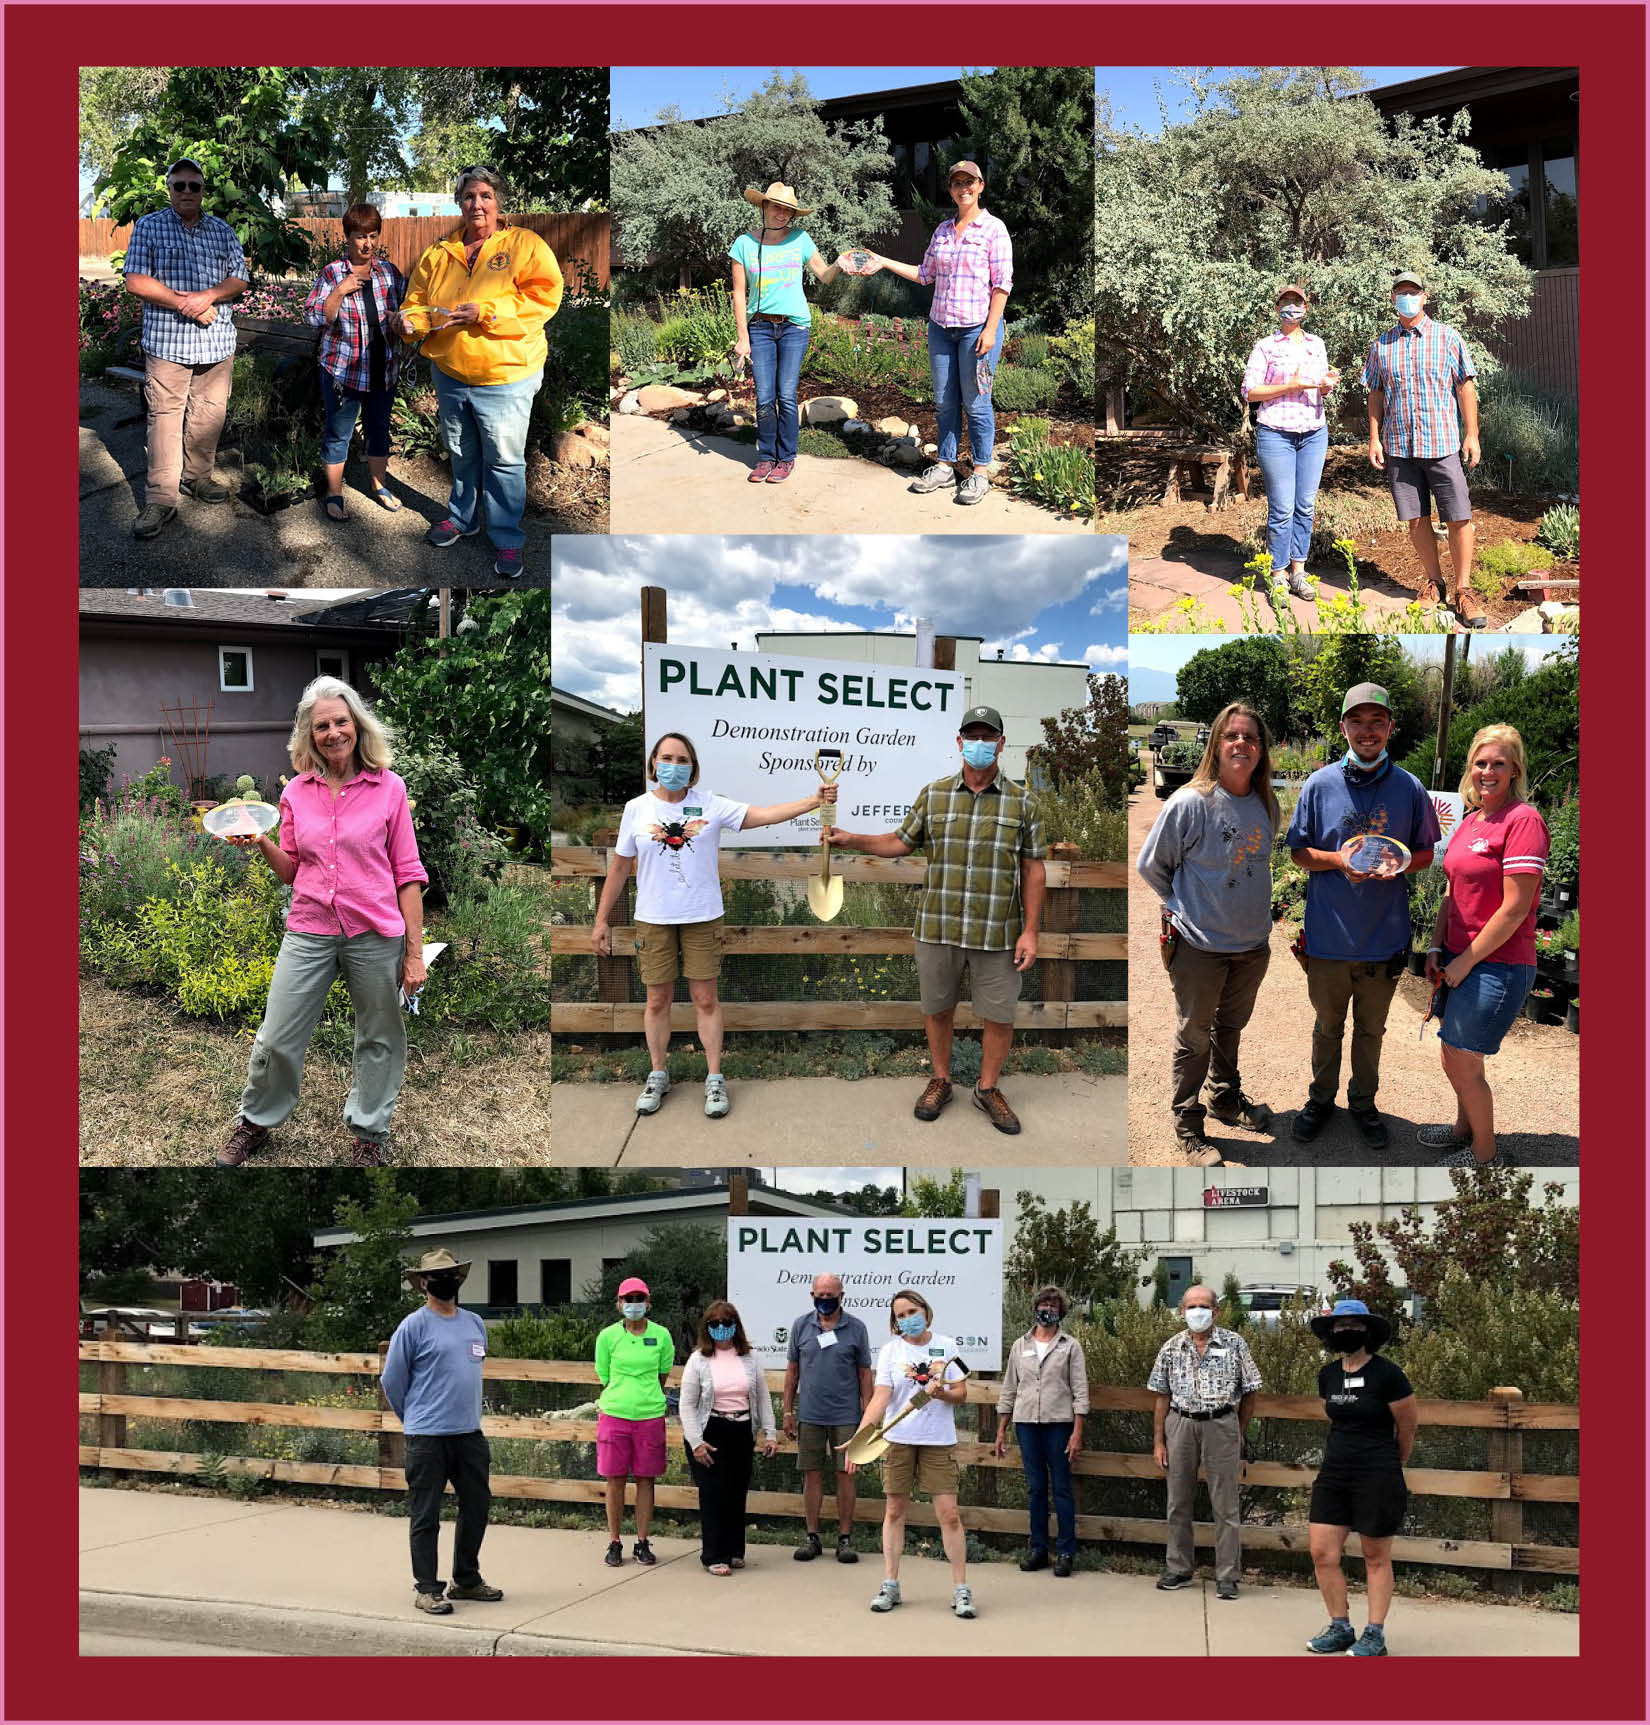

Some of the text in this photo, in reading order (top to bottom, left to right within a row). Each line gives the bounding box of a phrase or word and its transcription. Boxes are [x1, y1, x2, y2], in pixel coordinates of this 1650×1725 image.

[660, 658, 954, 712] PLANT SELECT
[711, 718, 916, 747] Demonstration Garden
[759, 751, 878, 776] Sponsored by
[790, 818, 810, 826] Plant
[1211, 1188, 1261, 1197] LIVESTOCK
[1211, 1197, 1241, 1205] ARENA
[738, 1227, 993, 1255] PLANT SELECT
[776, 1269, 956, 1286] Demtration Garden
